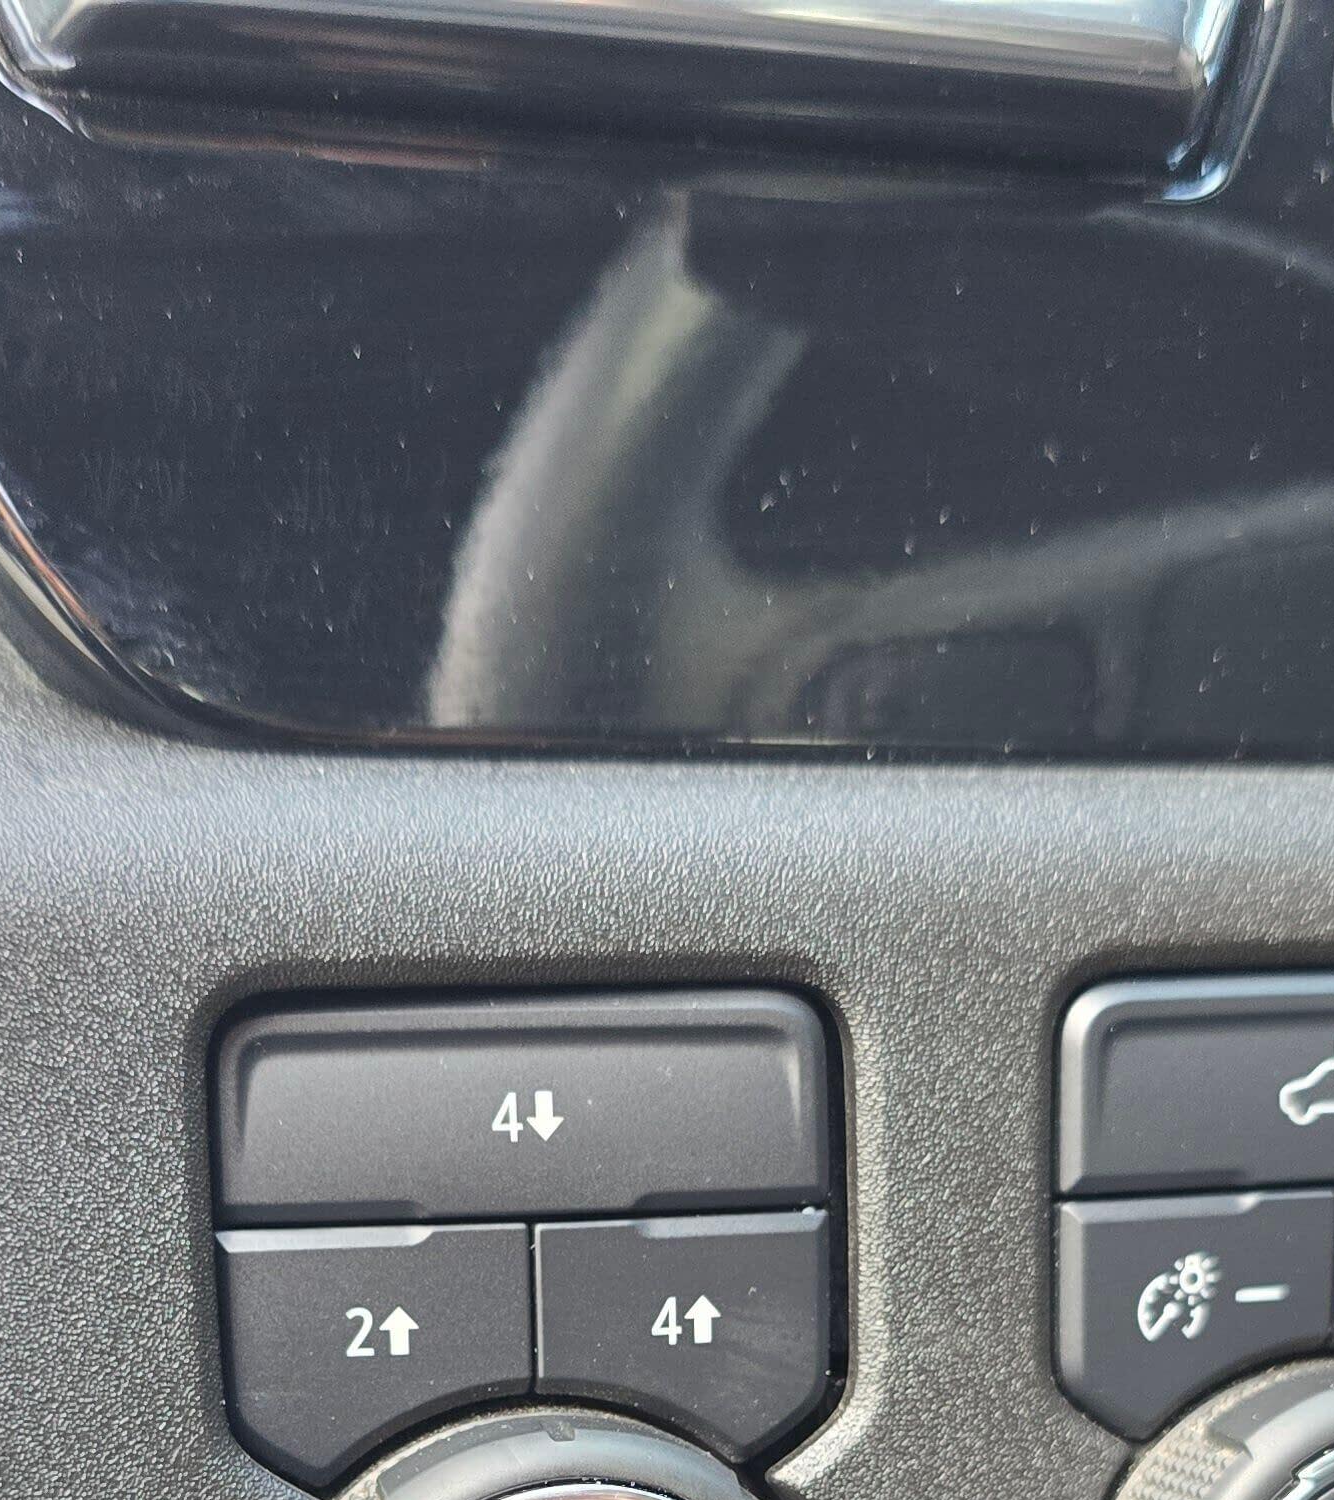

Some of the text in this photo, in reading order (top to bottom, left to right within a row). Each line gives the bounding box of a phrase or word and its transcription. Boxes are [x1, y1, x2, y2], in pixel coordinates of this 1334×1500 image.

[490, 1090, 524, 1144] 4
[345, 1306, 377, 1358] 2
[650, 1296, 684, 1346] 4
